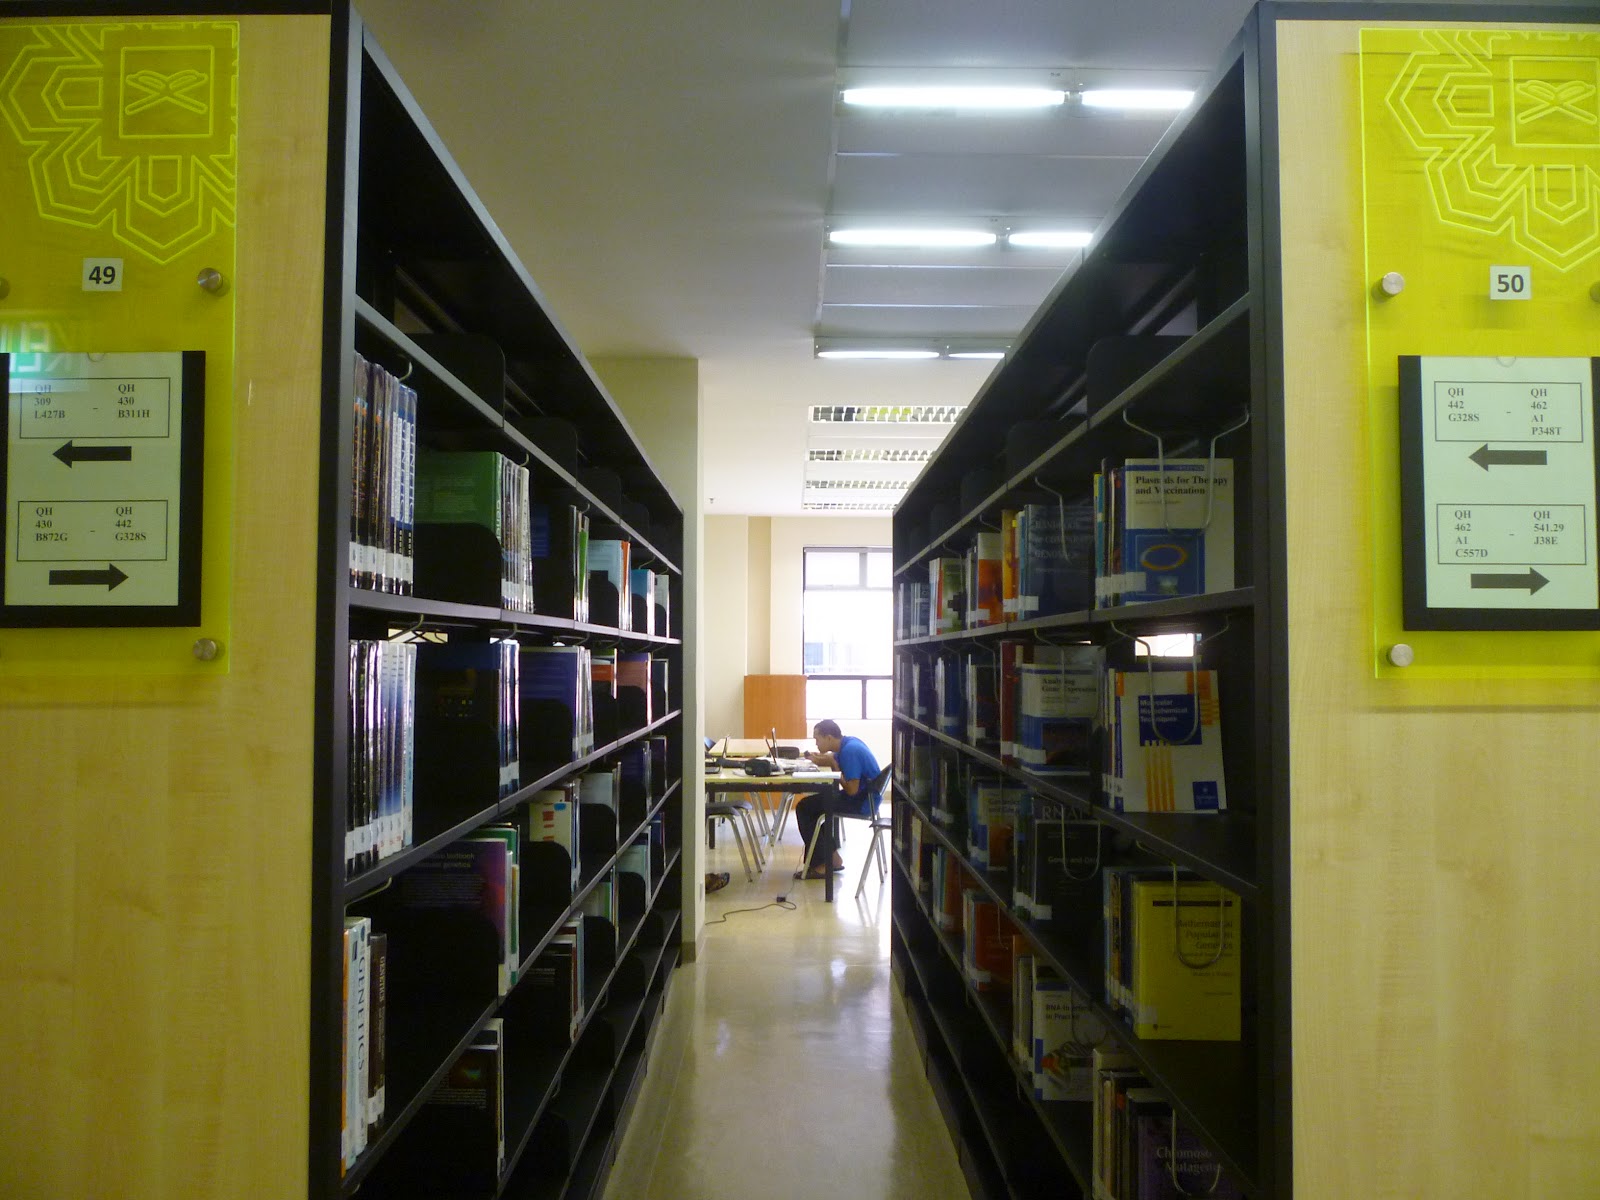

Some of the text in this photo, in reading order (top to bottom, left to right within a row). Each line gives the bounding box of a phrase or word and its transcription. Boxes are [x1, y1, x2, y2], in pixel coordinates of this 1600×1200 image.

[88, 265, 116, 284] 49
[1497, 274, 1525, 293] 50
[35, 384, 52, 395] QH
[118, 383, 135, 393] QH
[1447, 387, 1464, 397] QH
[1531, 388, 1547, 398] QH
[34, 397, 51, 406] 309
[117, 396, 135, 405] 430
[1447, 400, 1464, 409] 442
[1530, 401, 1547, 410] 462
[34, 409, 65, 419] L427B
[118, 408, 150, 418] B311H
[1448, 413, 1480, 422] G328S
[1531, 414, 1544, 423] A1
[1532, 427, 1561, 435] P348T
[1135, 475, 1228, 486] Plasmds for Theapy
[1135, 486, 1206, 495] and Vccination
[36, 506, 53, 517] QH
[116, 506, 133, 517] QH
[1454, 510, 1471, 520] QH
[1533, 511, 1550, 521] QH
[35, 520, 53, 529] 430
[115, 519, 132, 528] 442
[1454, 523, 1471, 531] 462
[1534, 523, 1564, 532] 541.29
[35, 533, 68, 542] B872G
[115, 532, 147, 541] G328S
[1456, 536, 1468, 545] A1
[1534, 536, 1558, 545] J38E
[1455, 548, 1488, 558] C557D
[358, 956, 366, 1071] GENETICS
